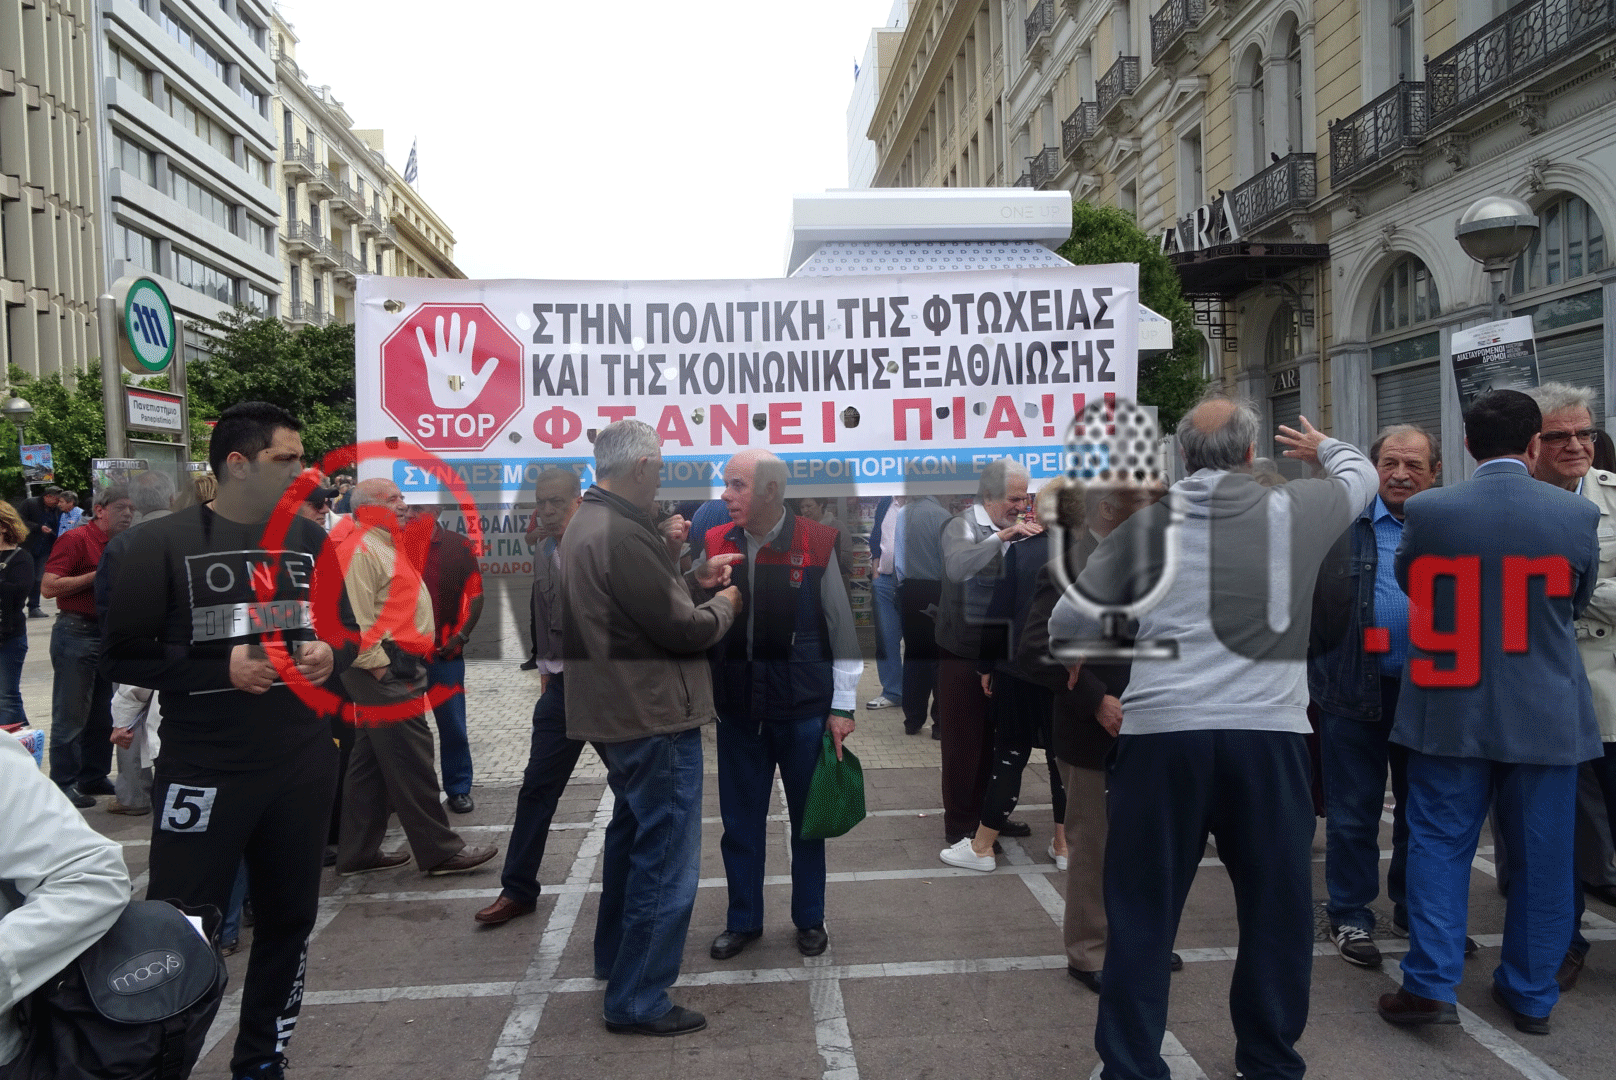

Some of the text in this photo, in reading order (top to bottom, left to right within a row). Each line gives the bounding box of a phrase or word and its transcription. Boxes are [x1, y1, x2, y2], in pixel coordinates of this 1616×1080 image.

[532, 287, 1114, 345] ΣΤΗΝ ΠΟΛΙΤΙΚΗ ΤΗΣ ΦΤΩΧΕΙΑΣ
[532, 339, 1116, 397] ΚΑΙ ΤΗΣ ΚΟΙΝΩΝΙΚΗΣ ΕΞΑΘΛΙΩΣΗΣ
[1271, 368, 1300, 392] ZAR
[133, 399, 177, 416] Πανεπιστήμιο
[140, 413, 172, 425] Panepistimio
[416, 413, 496, 439] STOP
[403, 459, 557, 485] ΣΥΝΔΕΣΜΟ
[456, 514, 532, 534] ΑΣΦΑΛΙΣ
[205, 560, 311, 593] ONE
[168, 787, 206, 831] 5
